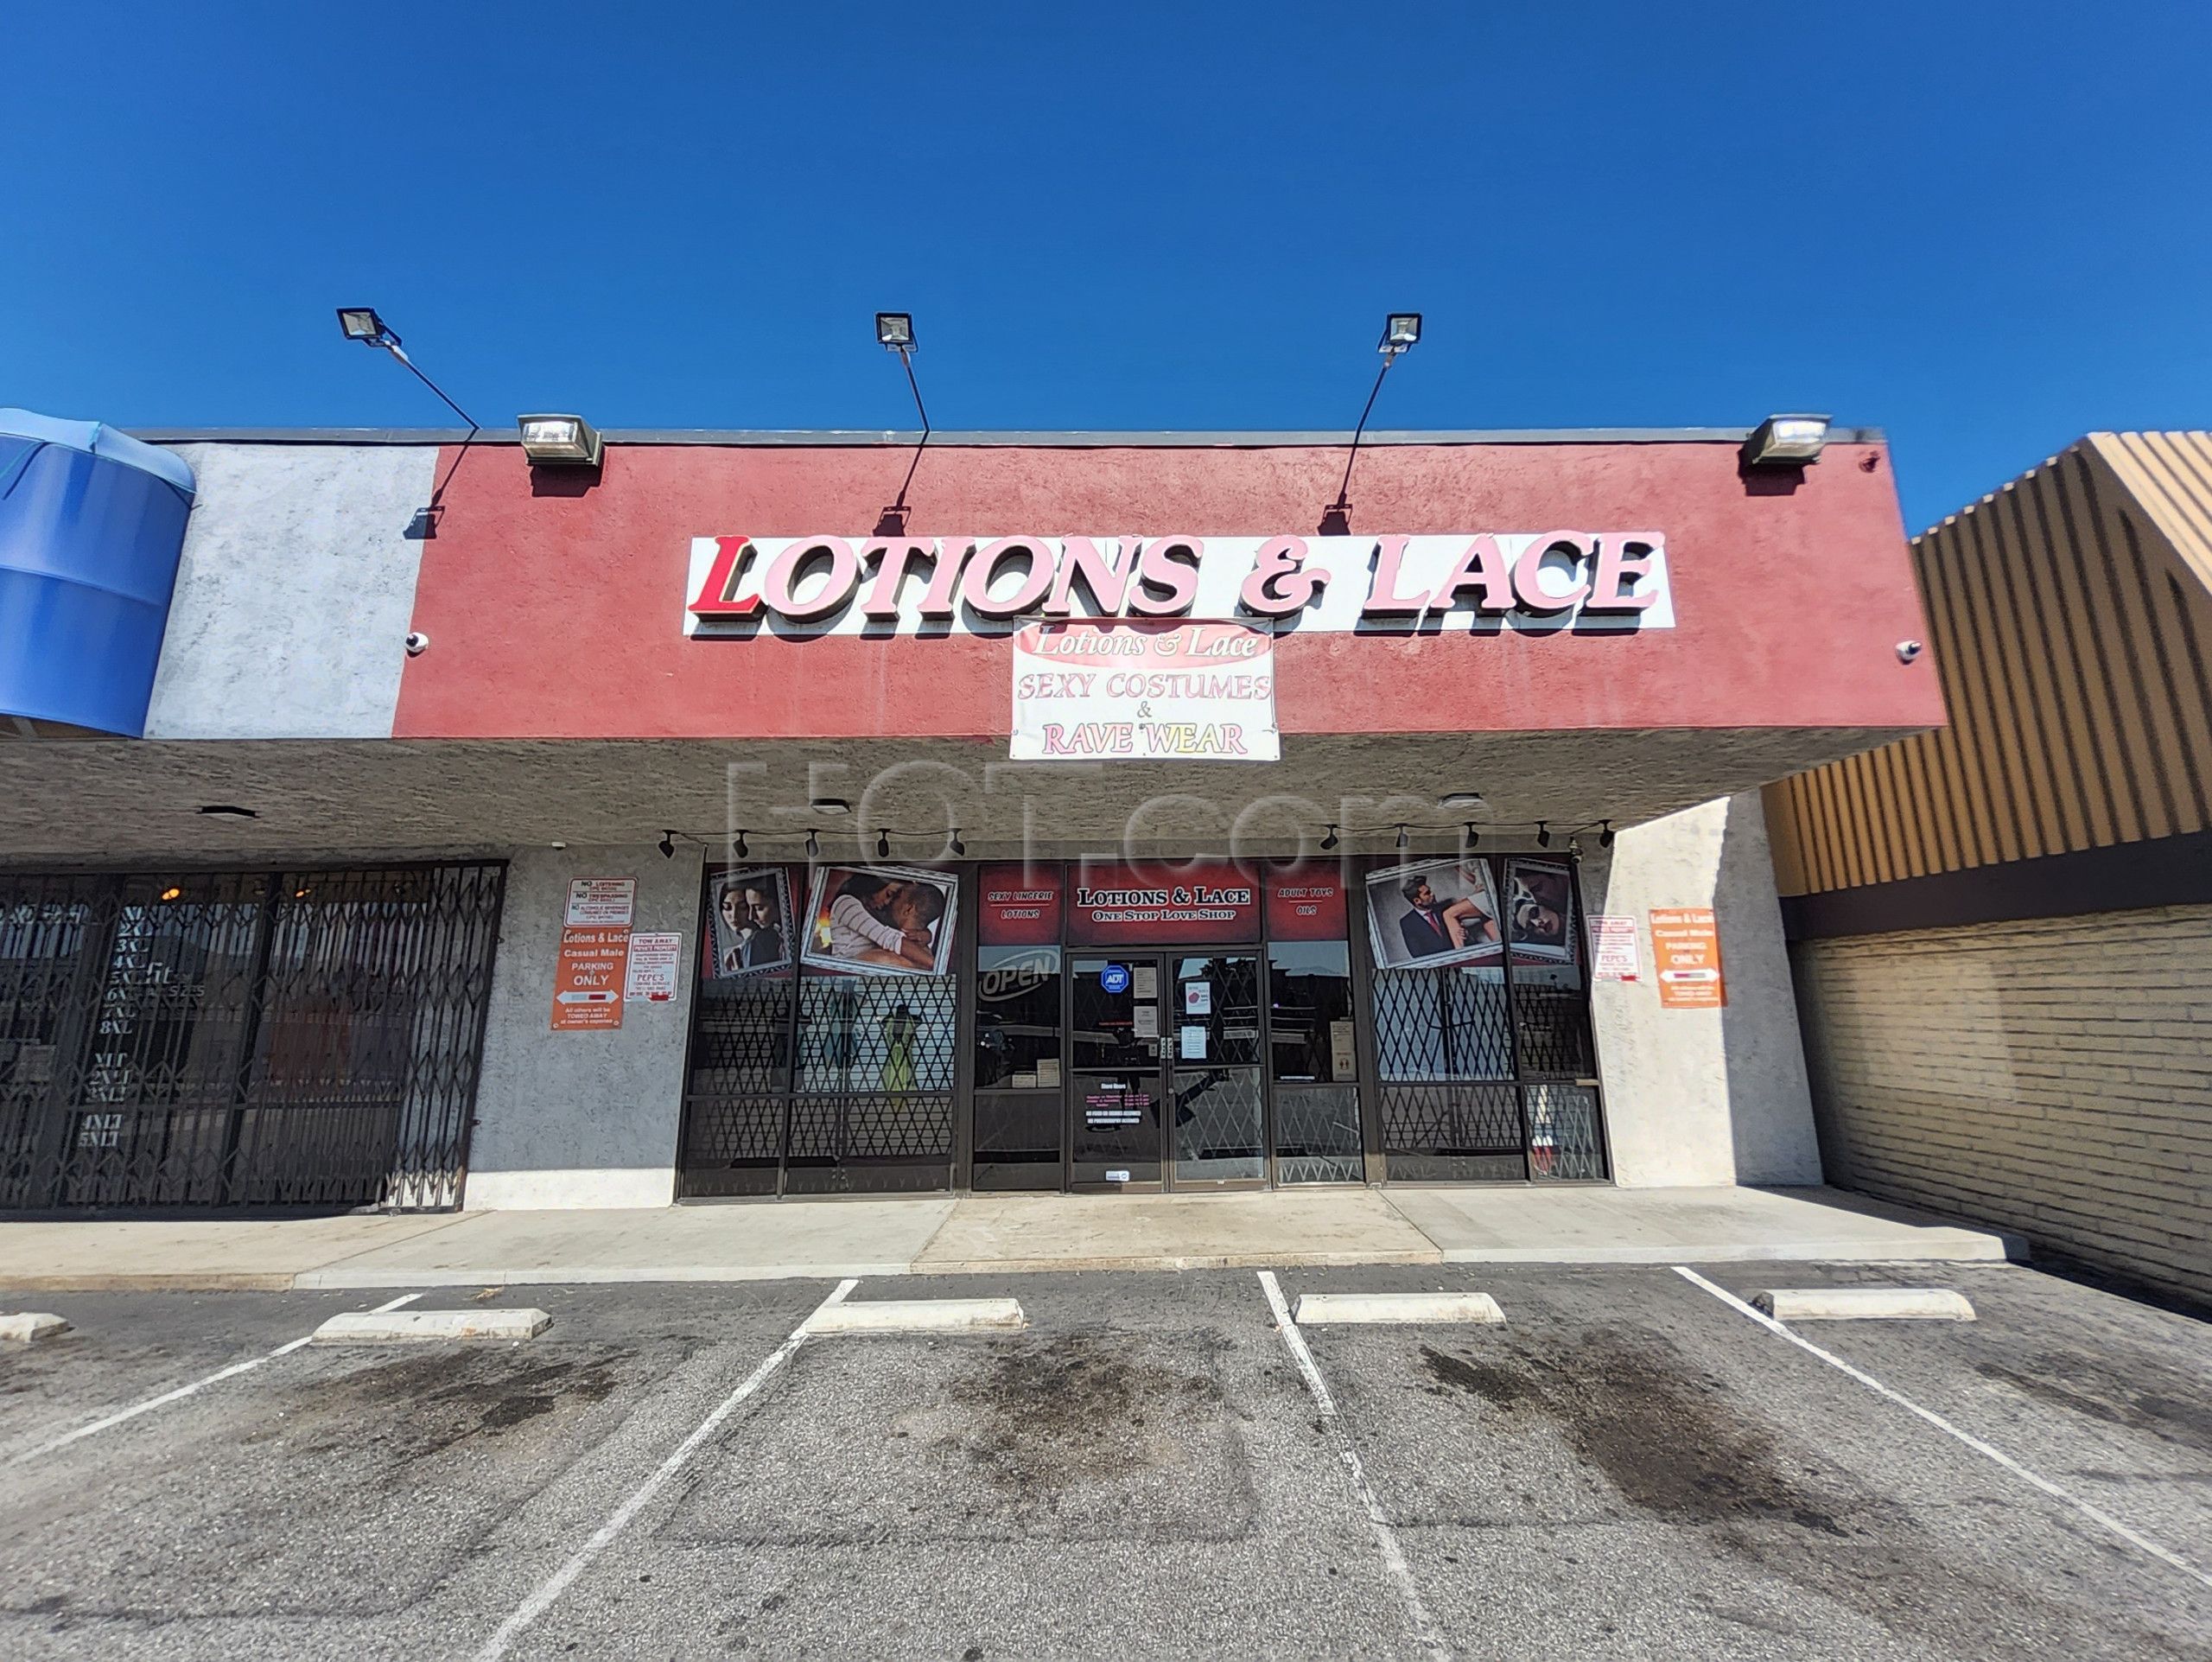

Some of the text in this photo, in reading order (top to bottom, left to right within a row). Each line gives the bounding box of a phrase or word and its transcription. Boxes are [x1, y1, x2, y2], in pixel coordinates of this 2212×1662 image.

[688, 530, 1665, 617] LOTIONS & LACE
[1032, 625, 1259, 658] Lotions & Lace
[1017, 672, 1272, 699] SEXY COSTUMES
[1137, 701, 1153, 718] &
[1042, 723, 1249, 755] RAVE WEAR
[988, 891, 1053, 901] SEXY LINGERIE
[1077, 886, 1250, 907] LOTIONS & LACE
[1278, 887, 1334, 897] ADULT TOYS
[1001, 909, 1040, 920] LOTIONS
[1092, 908, 1236, 922] ONE STOP LOVE SHOP
[1296, 905, 1317, 915] OILS
[563, 933, 629, 944] Lotions & Lace
[571, 962, 614, 971] PARKING
[574, 975, 609, 985] ONLY
[982, 956, 1051, 995] OPEN
[1105, 974, 1124, 984] ADT
[99, 1019, 133, 1035] 8XL
